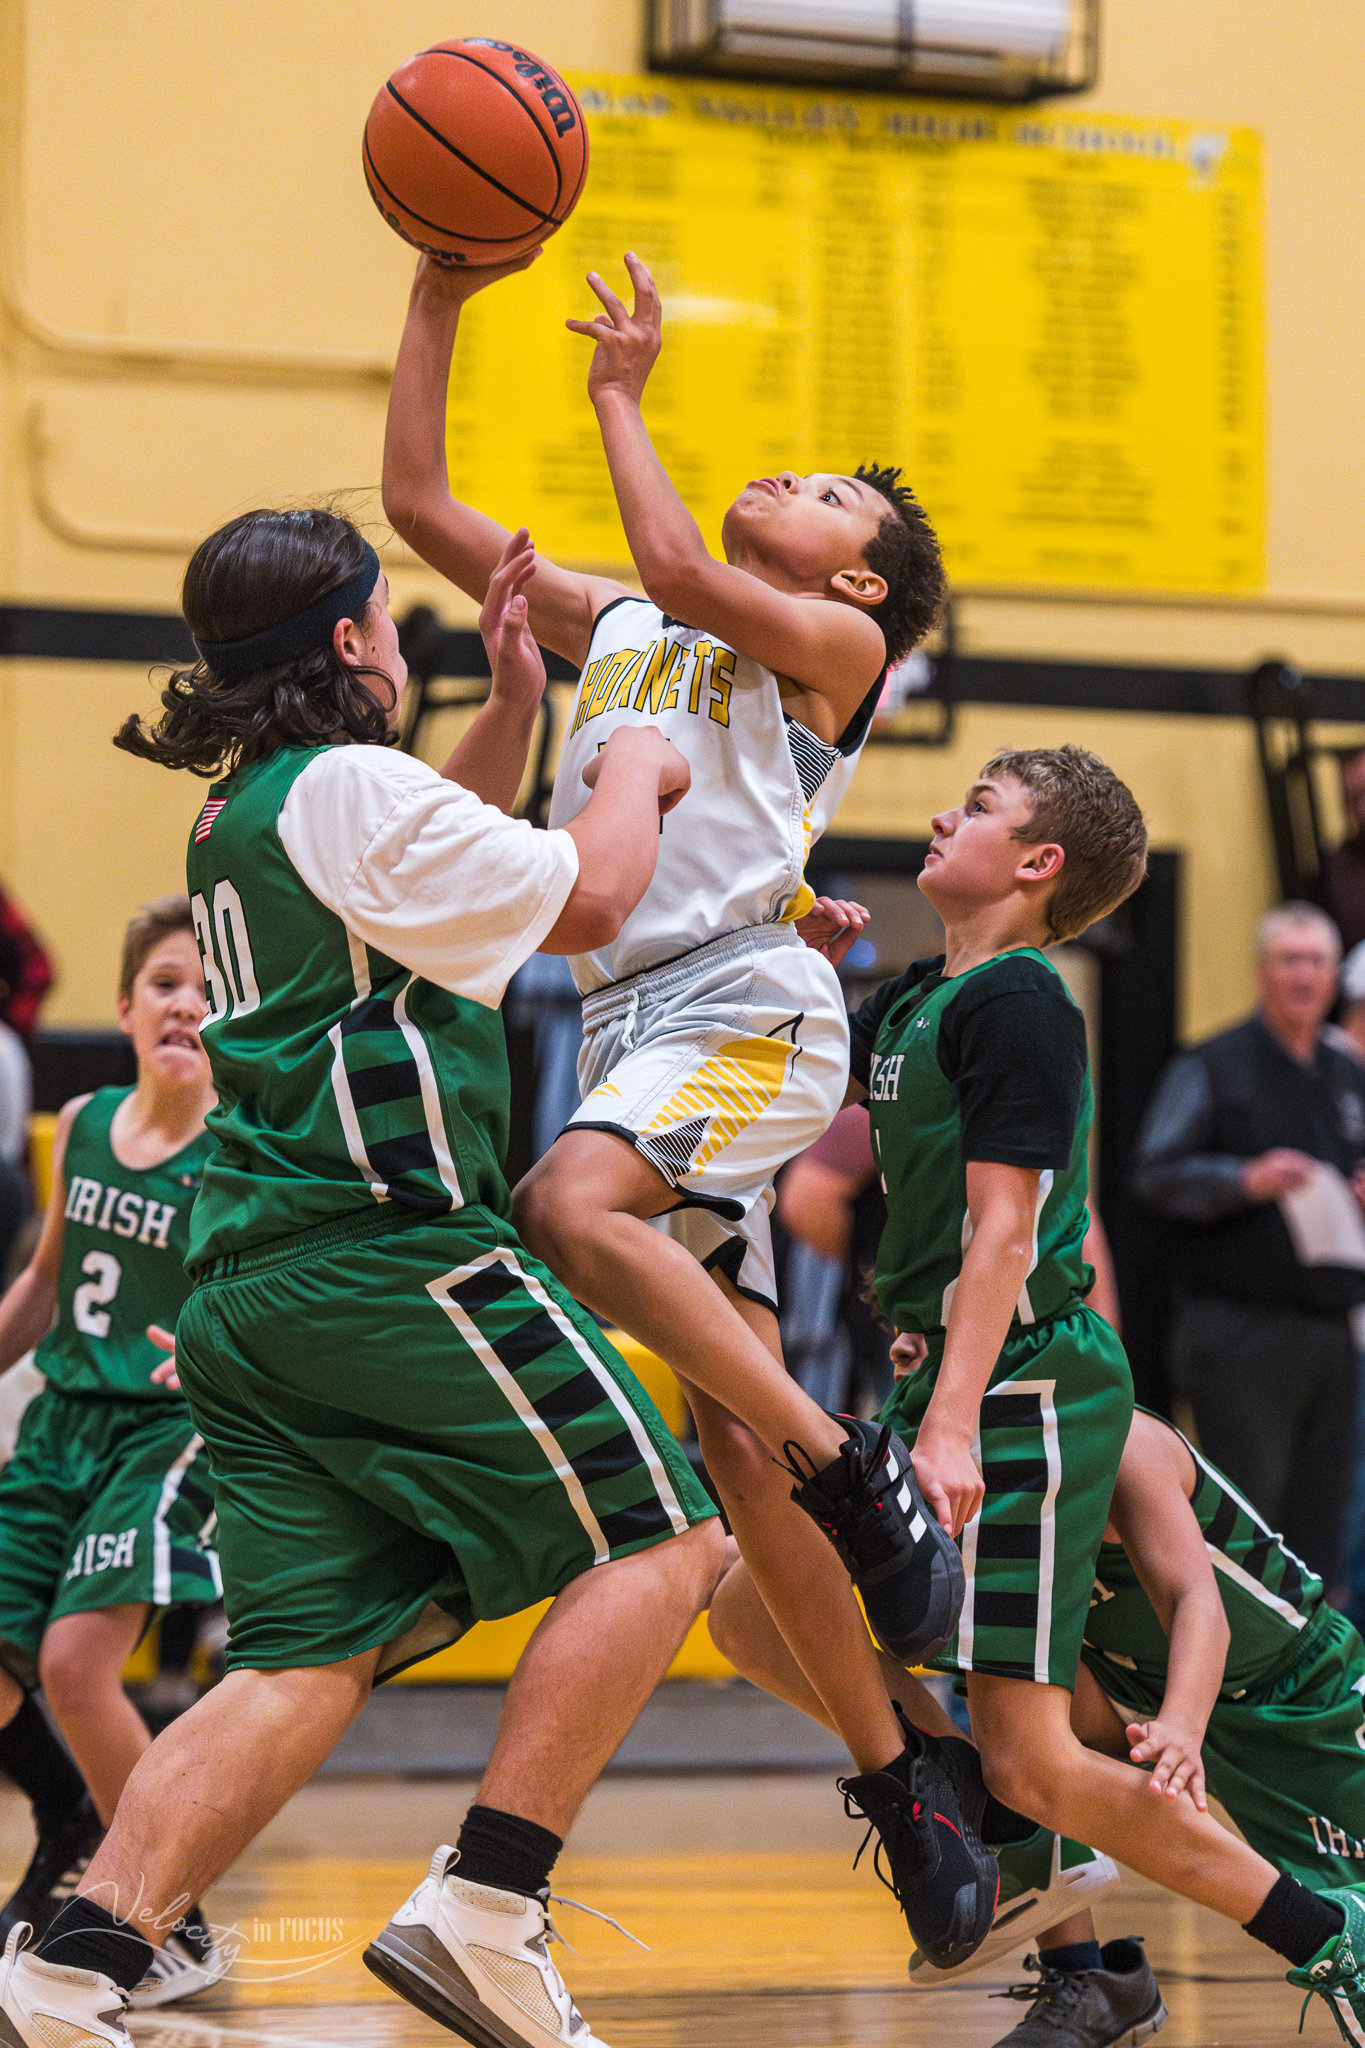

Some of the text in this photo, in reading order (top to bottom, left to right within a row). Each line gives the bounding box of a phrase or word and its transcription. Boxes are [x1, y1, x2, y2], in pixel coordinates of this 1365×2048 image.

[569, 637, 738, 740] HORNETS
[191, 875, 261, 1033] 30
[869, 1052, 905, 1101] ISH
[64, 1175, 177, 1249] IRISH
[73, 1249, 122, 1339] 2
[64, 1527, 138, 1583] ISH
